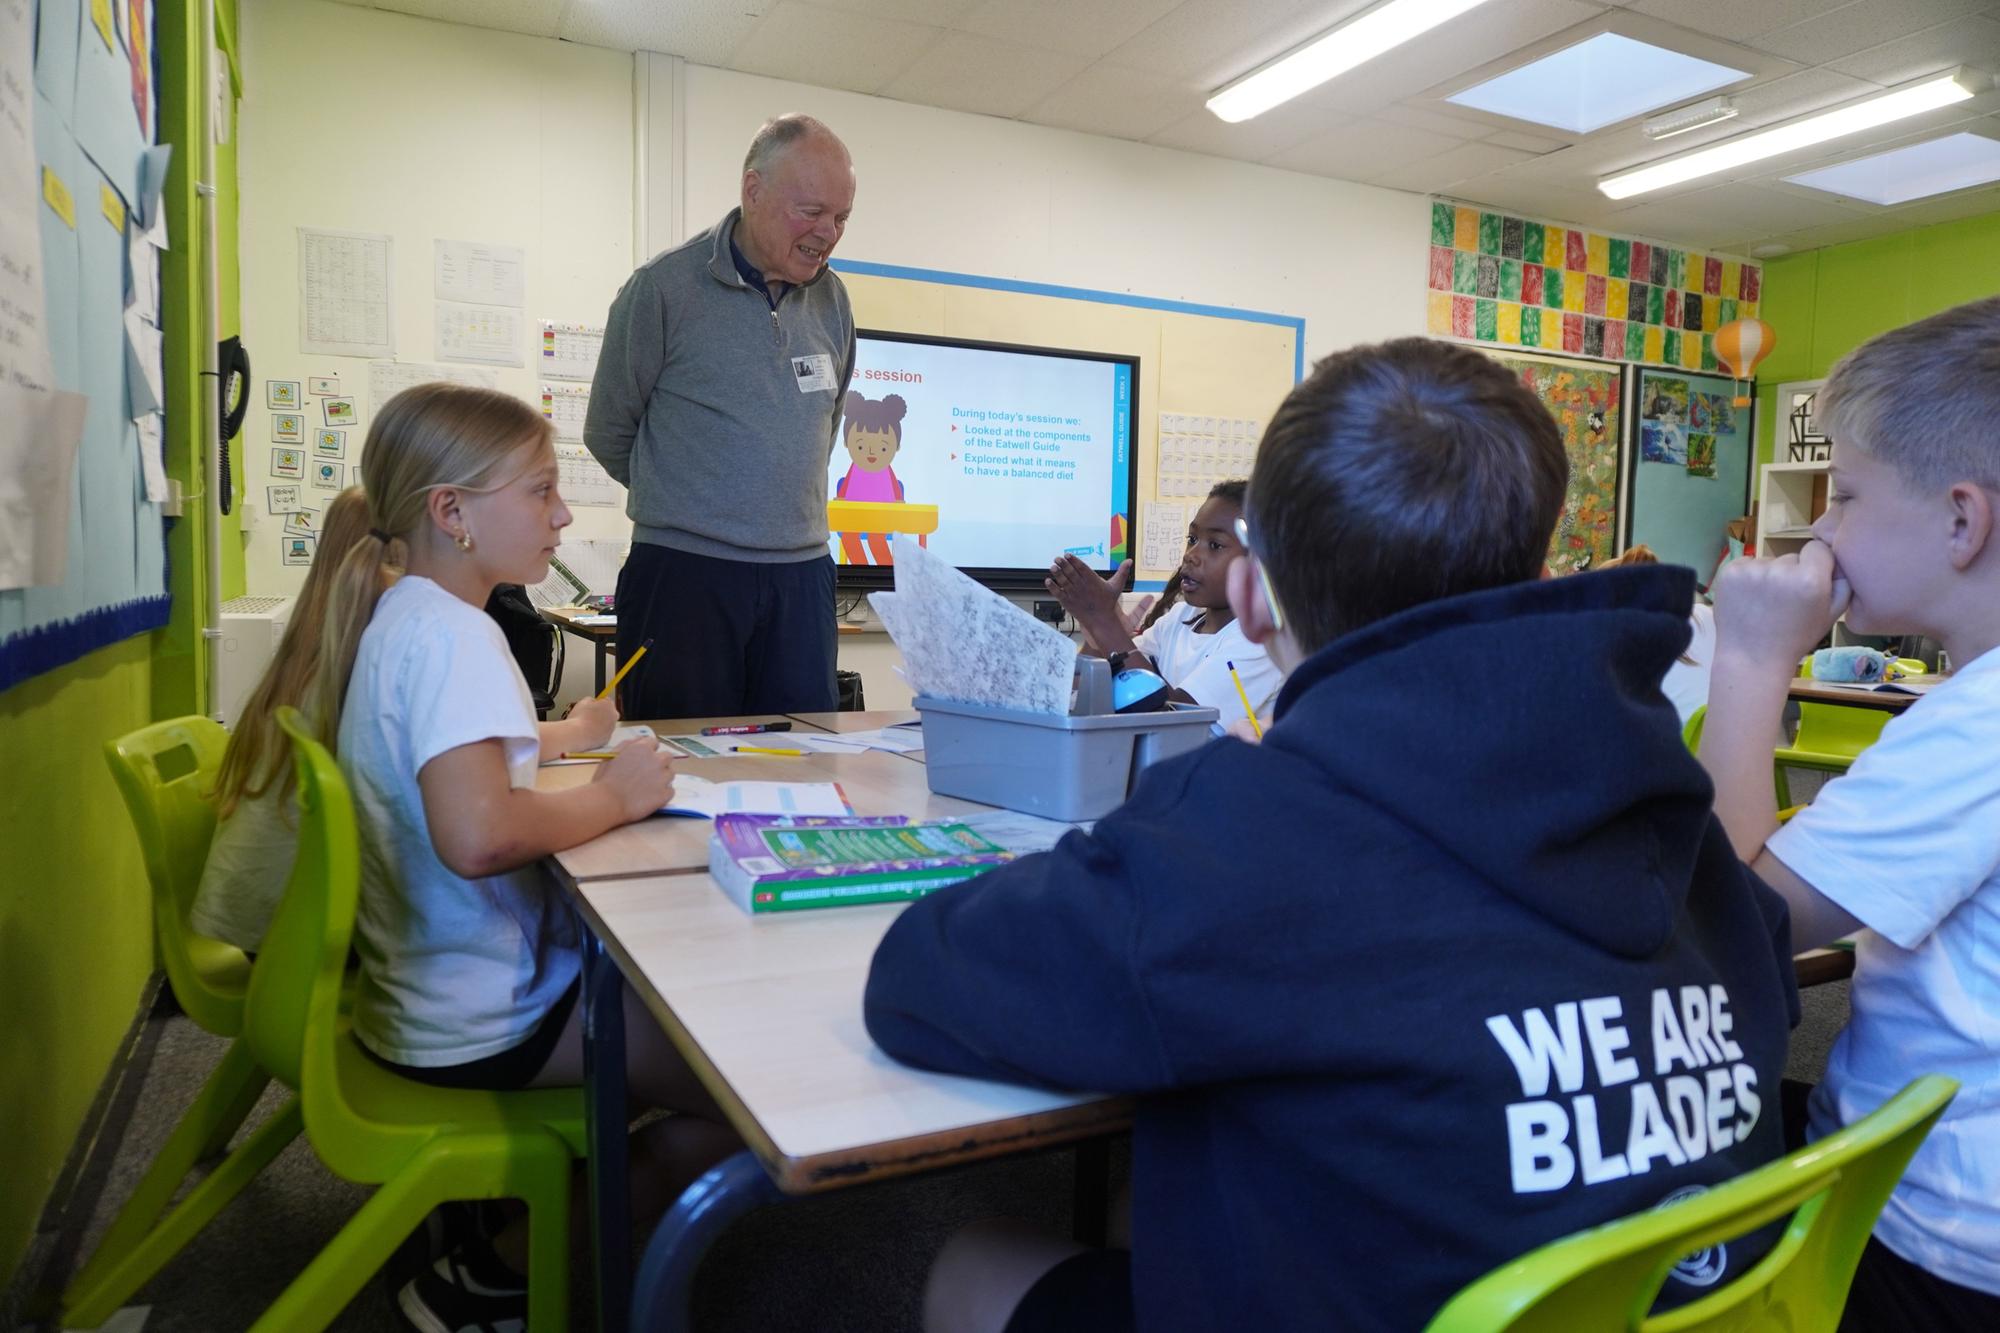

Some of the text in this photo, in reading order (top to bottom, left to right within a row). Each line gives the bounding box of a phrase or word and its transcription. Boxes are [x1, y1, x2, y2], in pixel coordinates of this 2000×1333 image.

[865, 369, 922, 383] session
[952, 407, 1081, 426] During today's session we:
[965, 425, 1091, 442] Looked at the components
[965, 438, 1060, 452] of the Eatwell Guide
[964, 453, 1076, 468] Explored what it means
[964, 466, 974, 475] to
[977, 467, 1000, 476] have
[1011, 468, 1054, 479] balanced
[1056, 470, 1074, 480] diet
[1485, 984, 1744, 1097] WE ARE
[1505, 1063, 1761, 1194] BLADES
